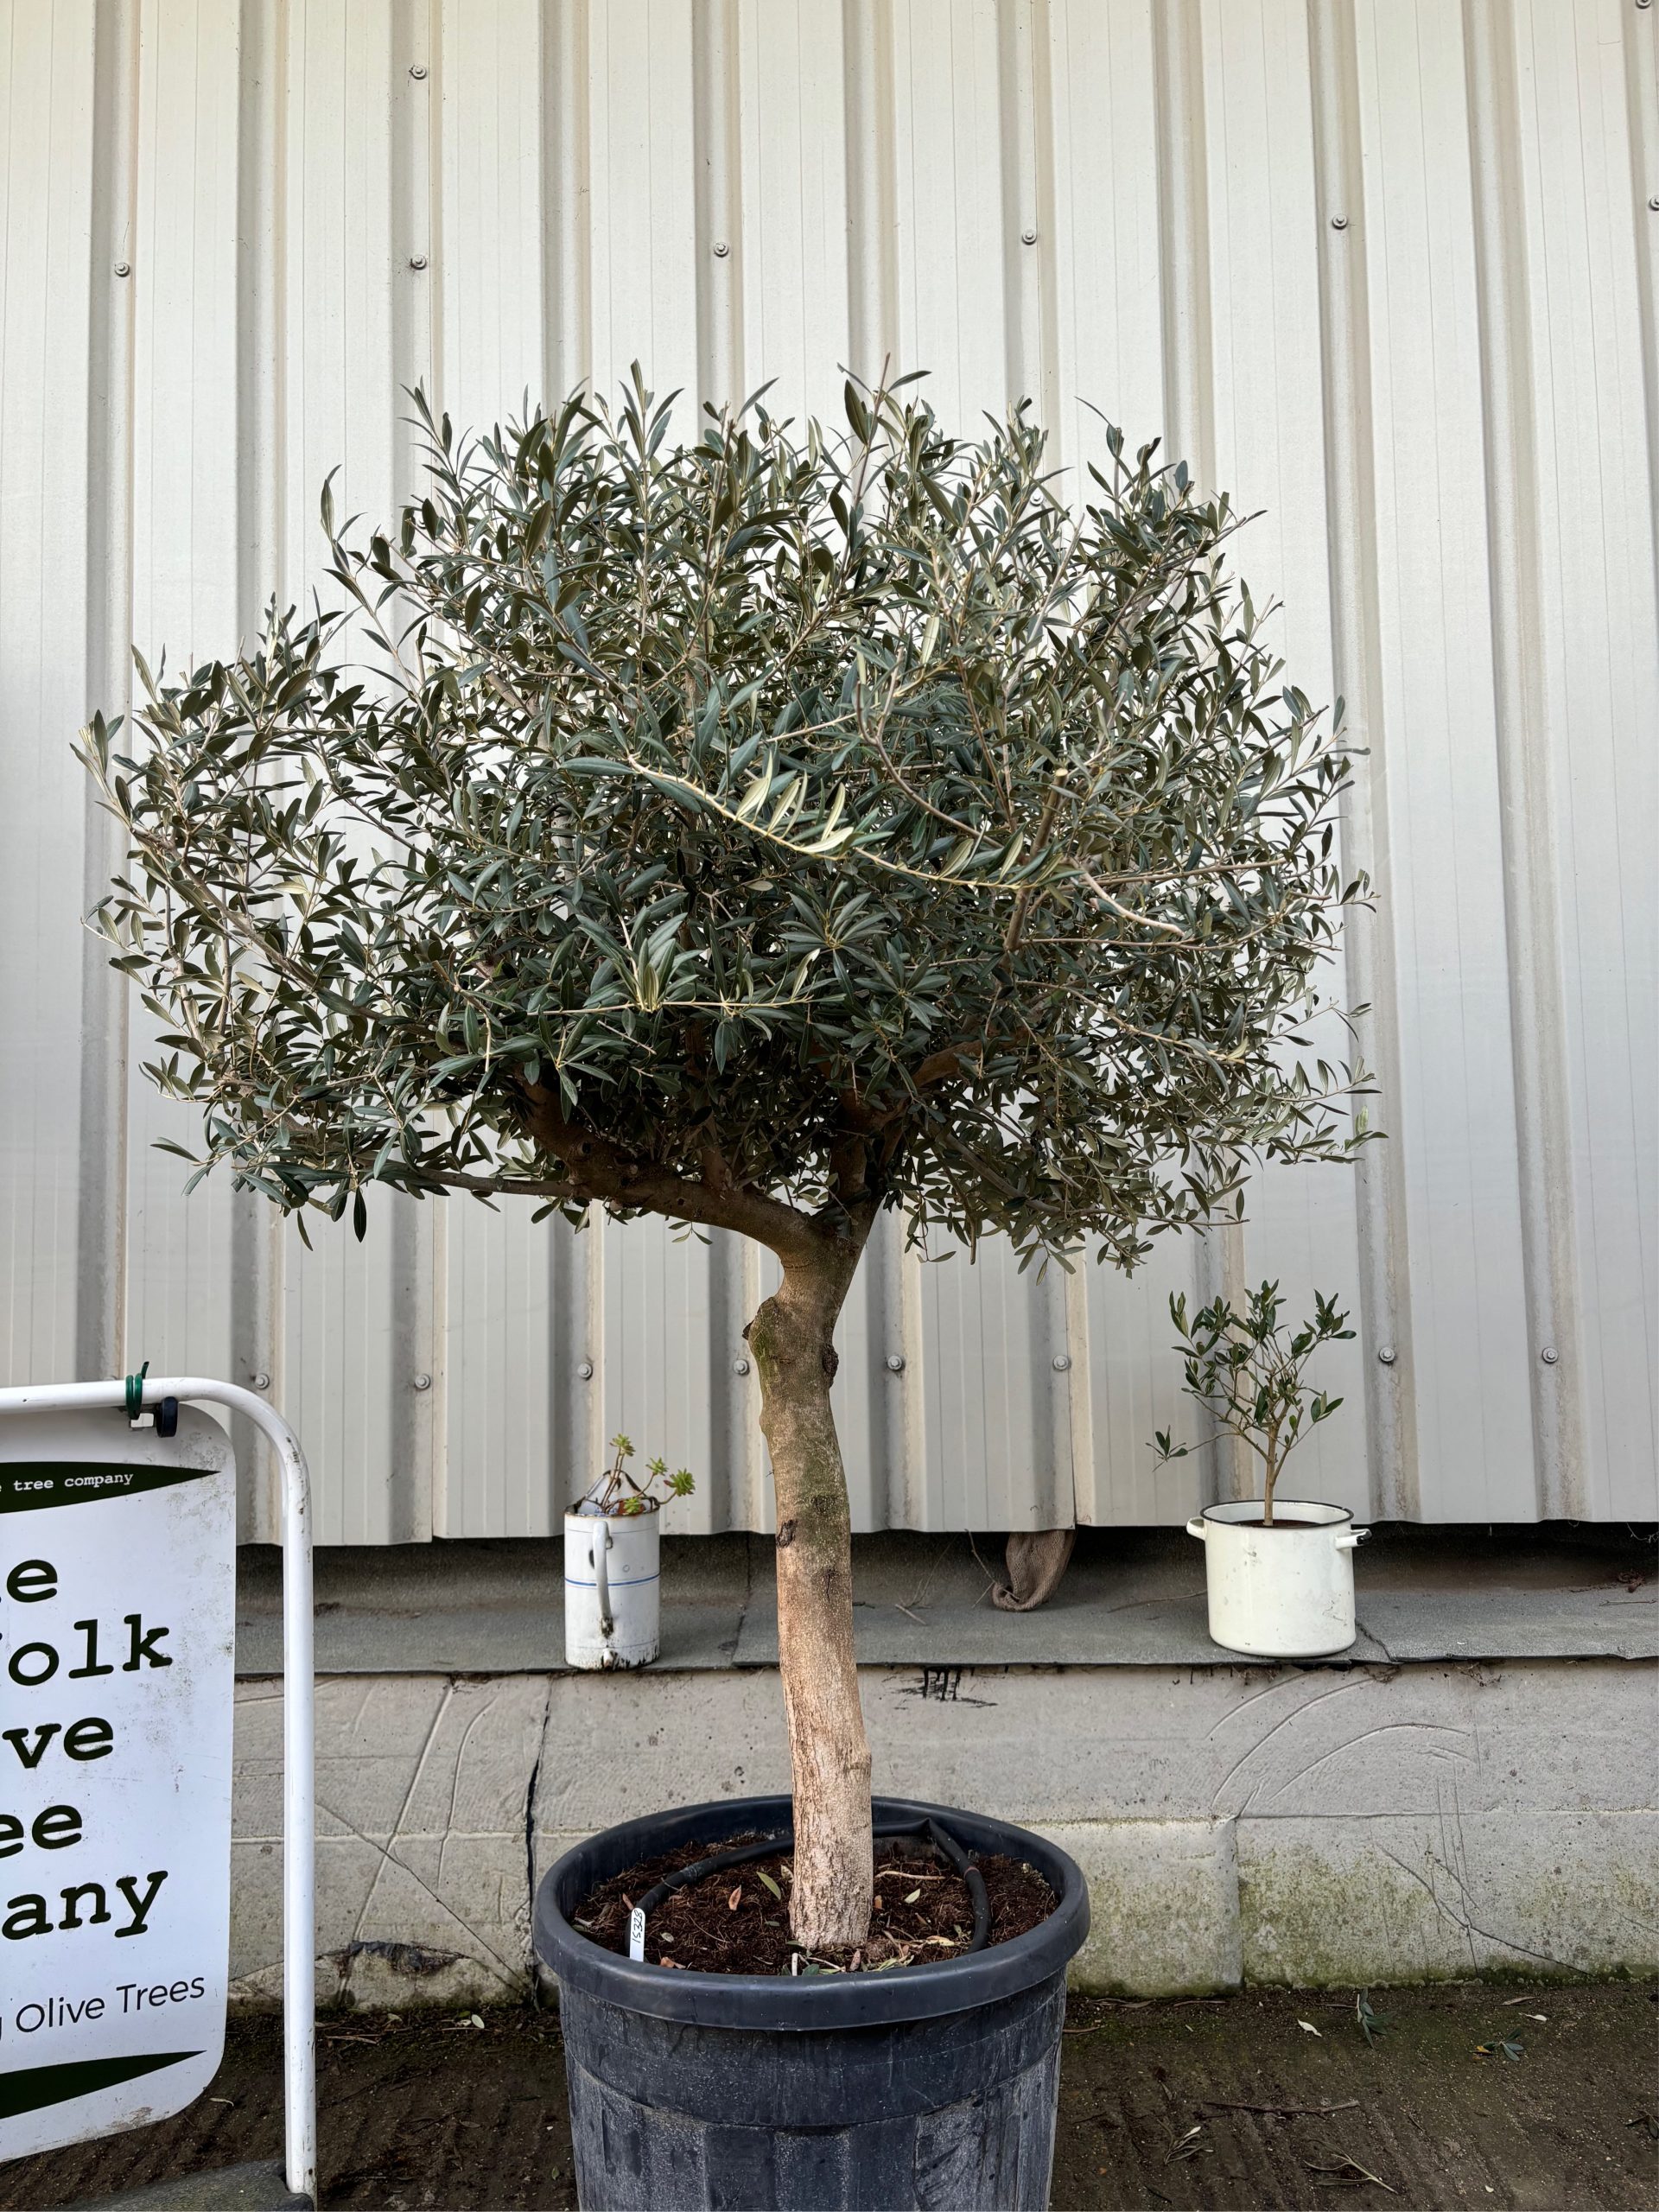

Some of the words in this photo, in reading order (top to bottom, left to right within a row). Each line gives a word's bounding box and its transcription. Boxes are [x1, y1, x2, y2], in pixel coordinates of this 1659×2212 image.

[13, 1479, 54, 1491] tree
[64, 1473, 134, 1488] company
[0, 1613, 173, 1687] olk
[2, 1717, 114, 1770] ve
[1, 1870, 168, 1941] any
[16, 1996, 105, 2033] Olive
[116, 1976, 205, 2013] Trees
